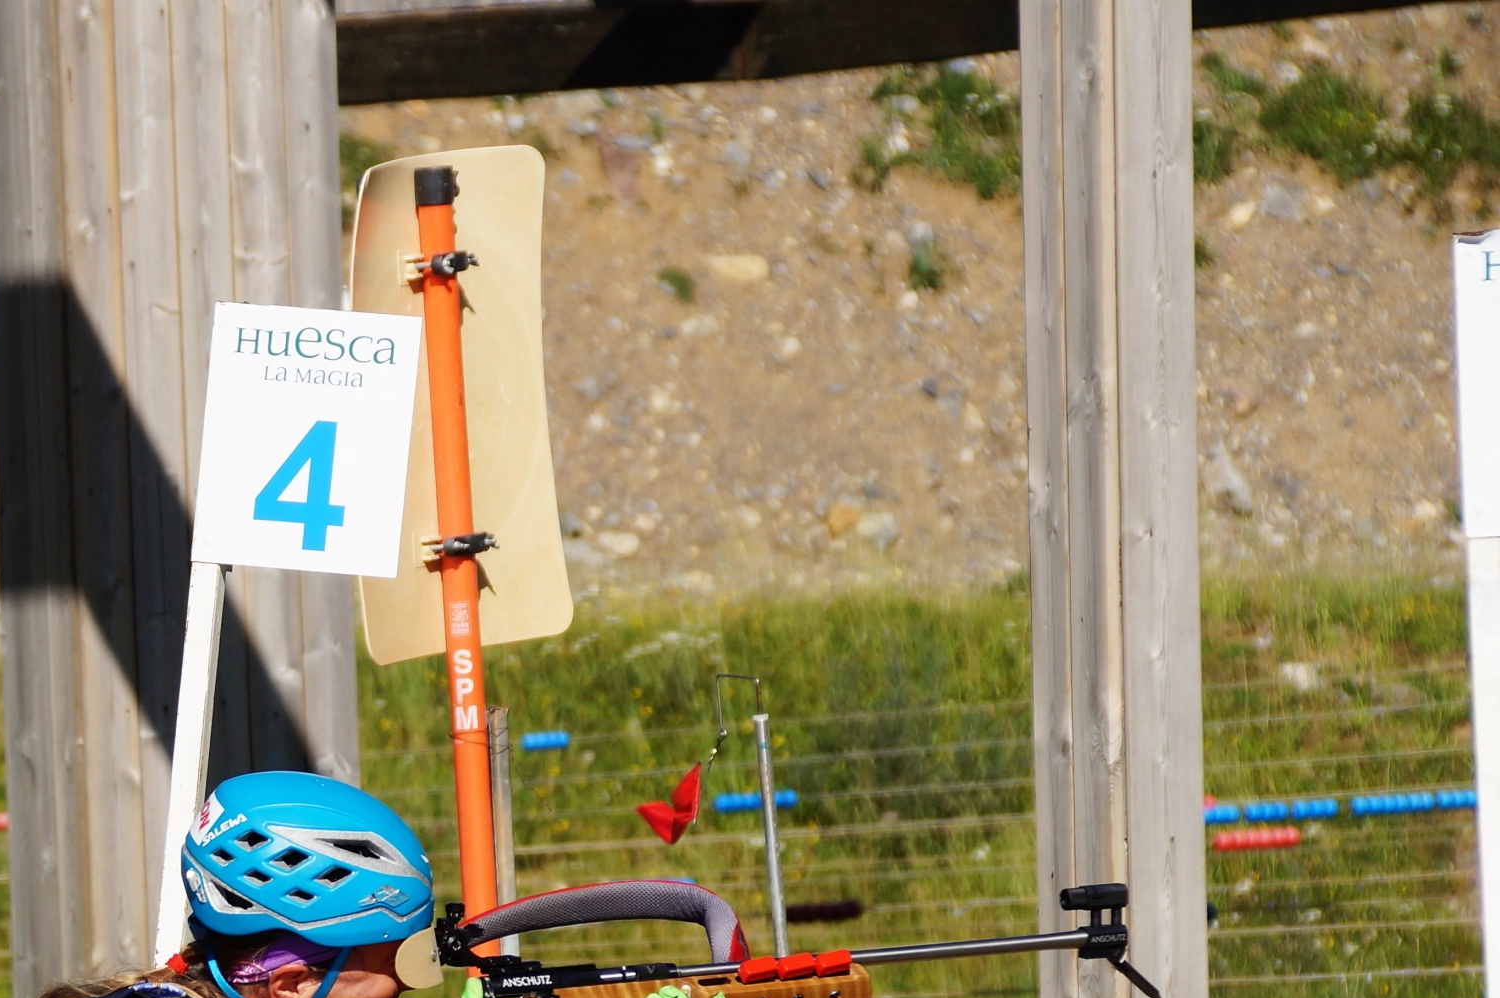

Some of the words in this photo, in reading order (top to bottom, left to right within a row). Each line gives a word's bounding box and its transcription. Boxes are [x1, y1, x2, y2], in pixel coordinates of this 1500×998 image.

[233, 326, 397, 366] Huesca
[253, 420, 346, 552] 4
[201, 813, 248, 847] SALEWA
